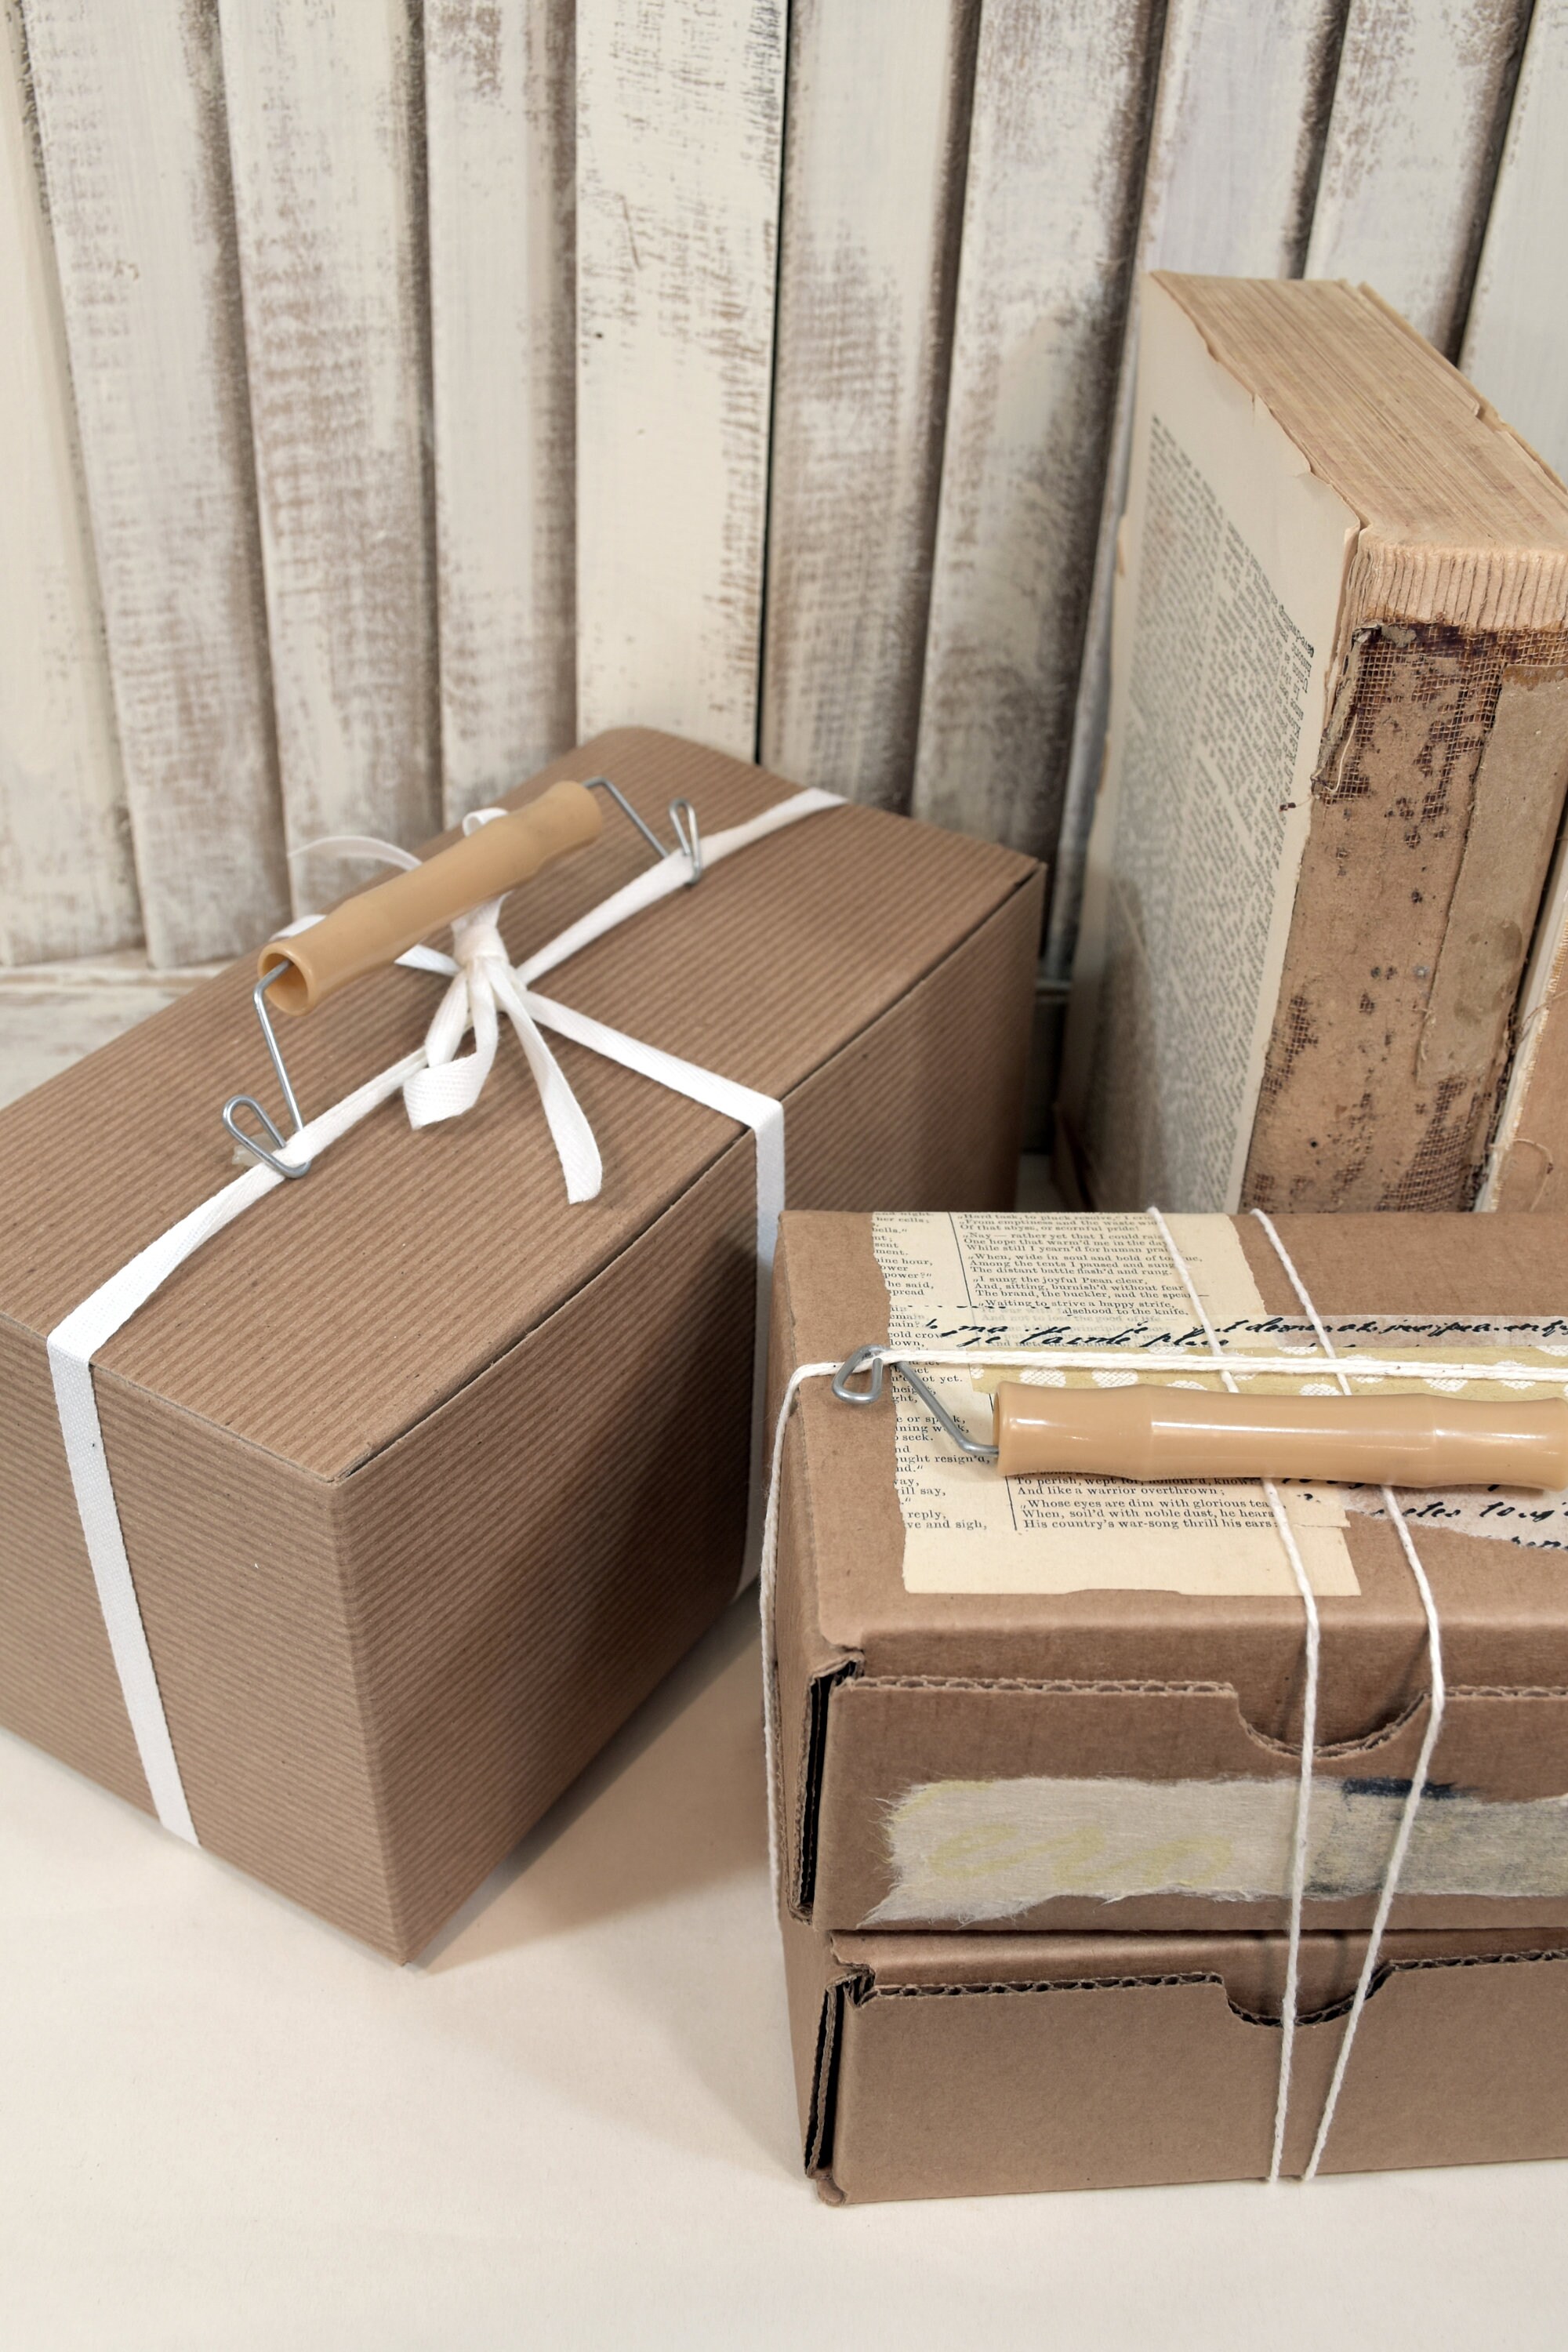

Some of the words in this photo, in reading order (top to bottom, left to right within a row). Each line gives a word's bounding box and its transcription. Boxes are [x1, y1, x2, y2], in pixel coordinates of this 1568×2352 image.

[941, 1375, 963, 1384] yet.
[902, 1432, 933, 1441] seek.
[1014, 1476, 1032, 1485] To
[1037, 1476, 1082, 1487] perish,
[1084, 1478, 1116, 1486] wept
[920, 1488, 946, 1497] say,
[1141, 1486, 1225, 1495] overthrown;
[1074, 1501, 1102, 1510] eyes
[1128, 1499, 1154, 1508] dim
[1160, 1499, 1189, 1508] with
[1193, 1499, 1247, 1509] glorious
[908, 1509, 946, 1520] reply,
[1022, 1509, 1065, 1519] When,
[1109, 1509, 1139, 1518] with
[1183, 1509, 1217, 1519] dust,
[1239, 1509, 1275, 1518] hears
[926, 1520, 950, 1529] and
[956, 1520, 987, 1531] sigh,
[1023, 1519, 1047, 1528] His
[1051, 1519, 1115, 1530] country's
[1119, 1519, 1179, 1530] war-song
[1183, 1519, 1218, 1527] thrill
[1221, 1519, 1242, 1527] his
